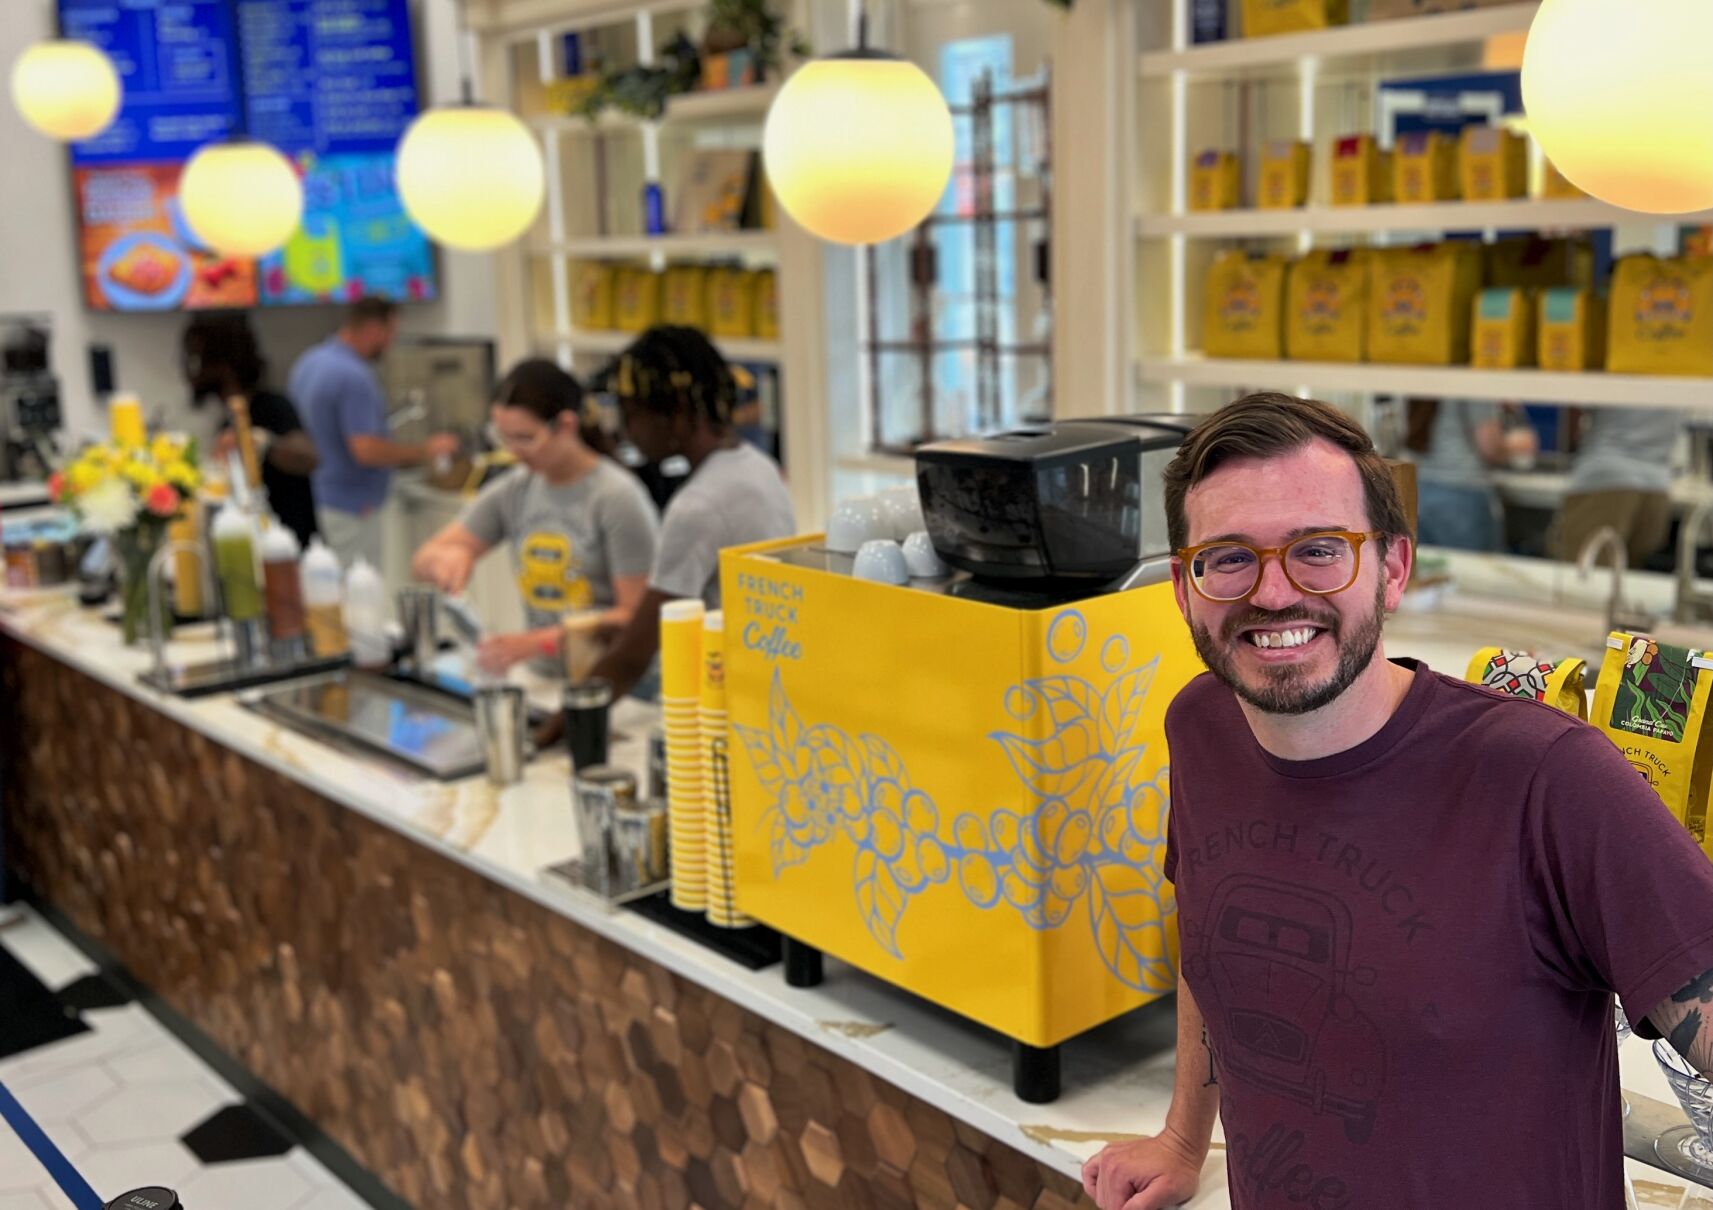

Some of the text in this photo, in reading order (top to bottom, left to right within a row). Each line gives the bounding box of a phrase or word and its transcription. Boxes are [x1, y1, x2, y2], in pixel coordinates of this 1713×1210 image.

[737, 572, 804, 601] FRENCH
[744, 596, 798, 624] TRUCK
[742, 621, 803, 661] Coffee
[1620, 720, 1652, 732] COLOMBIA
[1645, 751, 1671, 776] TRUCK
[1187, 819, 1437, 943] RENCH TRUCK
[1231, 1122, 1354, 1210] offee
[131, 1196, 159, 1209] ULINE
